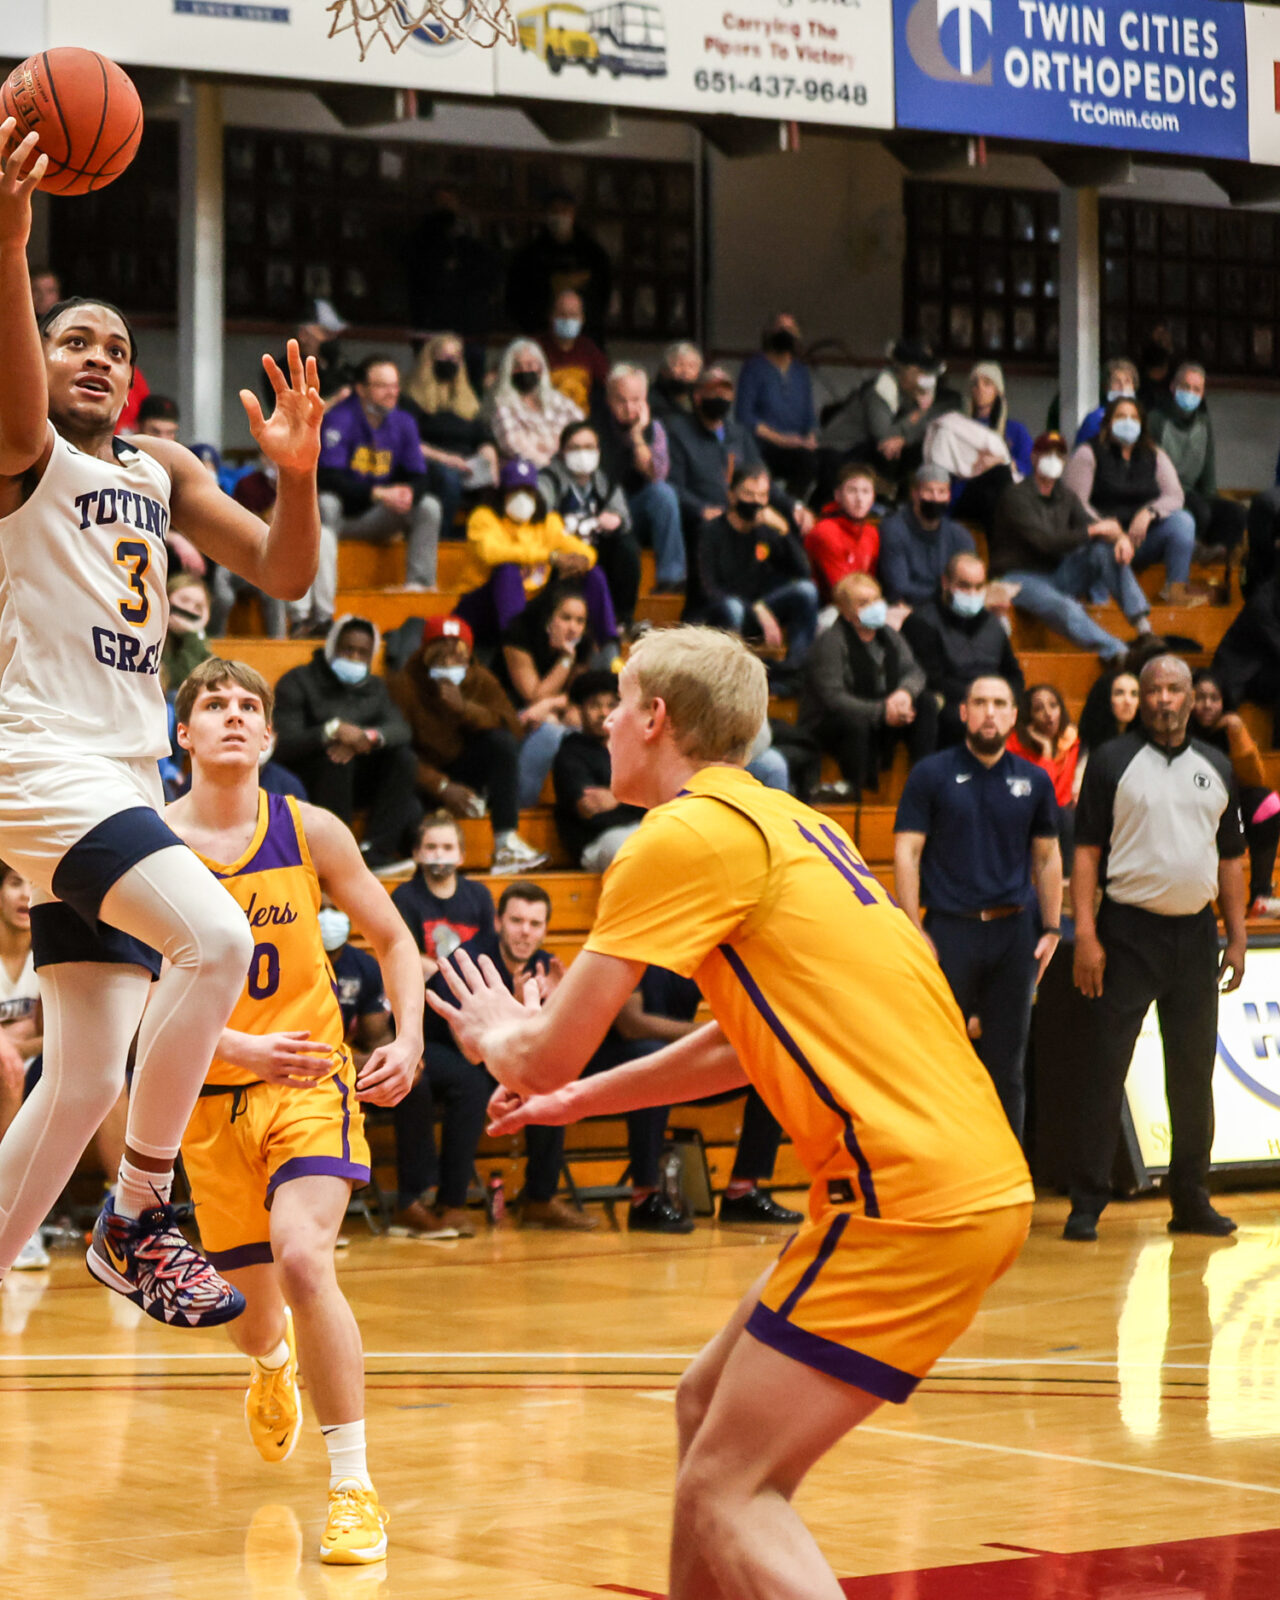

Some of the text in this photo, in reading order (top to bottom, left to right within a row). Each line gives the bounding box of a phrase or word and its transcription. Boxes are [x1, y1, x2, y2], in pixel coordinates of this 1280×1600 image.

[722, 12, 838, 40] Carrying The
[1019, 0, 1219, 59] TWIN CITIES
[704, 36, 854, 70] Pipers To Victory
[693, 69, 868, 106] 651-437-9648
[1004, 46, 1237, 110] ORTHOPEDICS
[1070, 98, 1180, 132] TCOmn.com
[113, 537, 152, 628] 3
